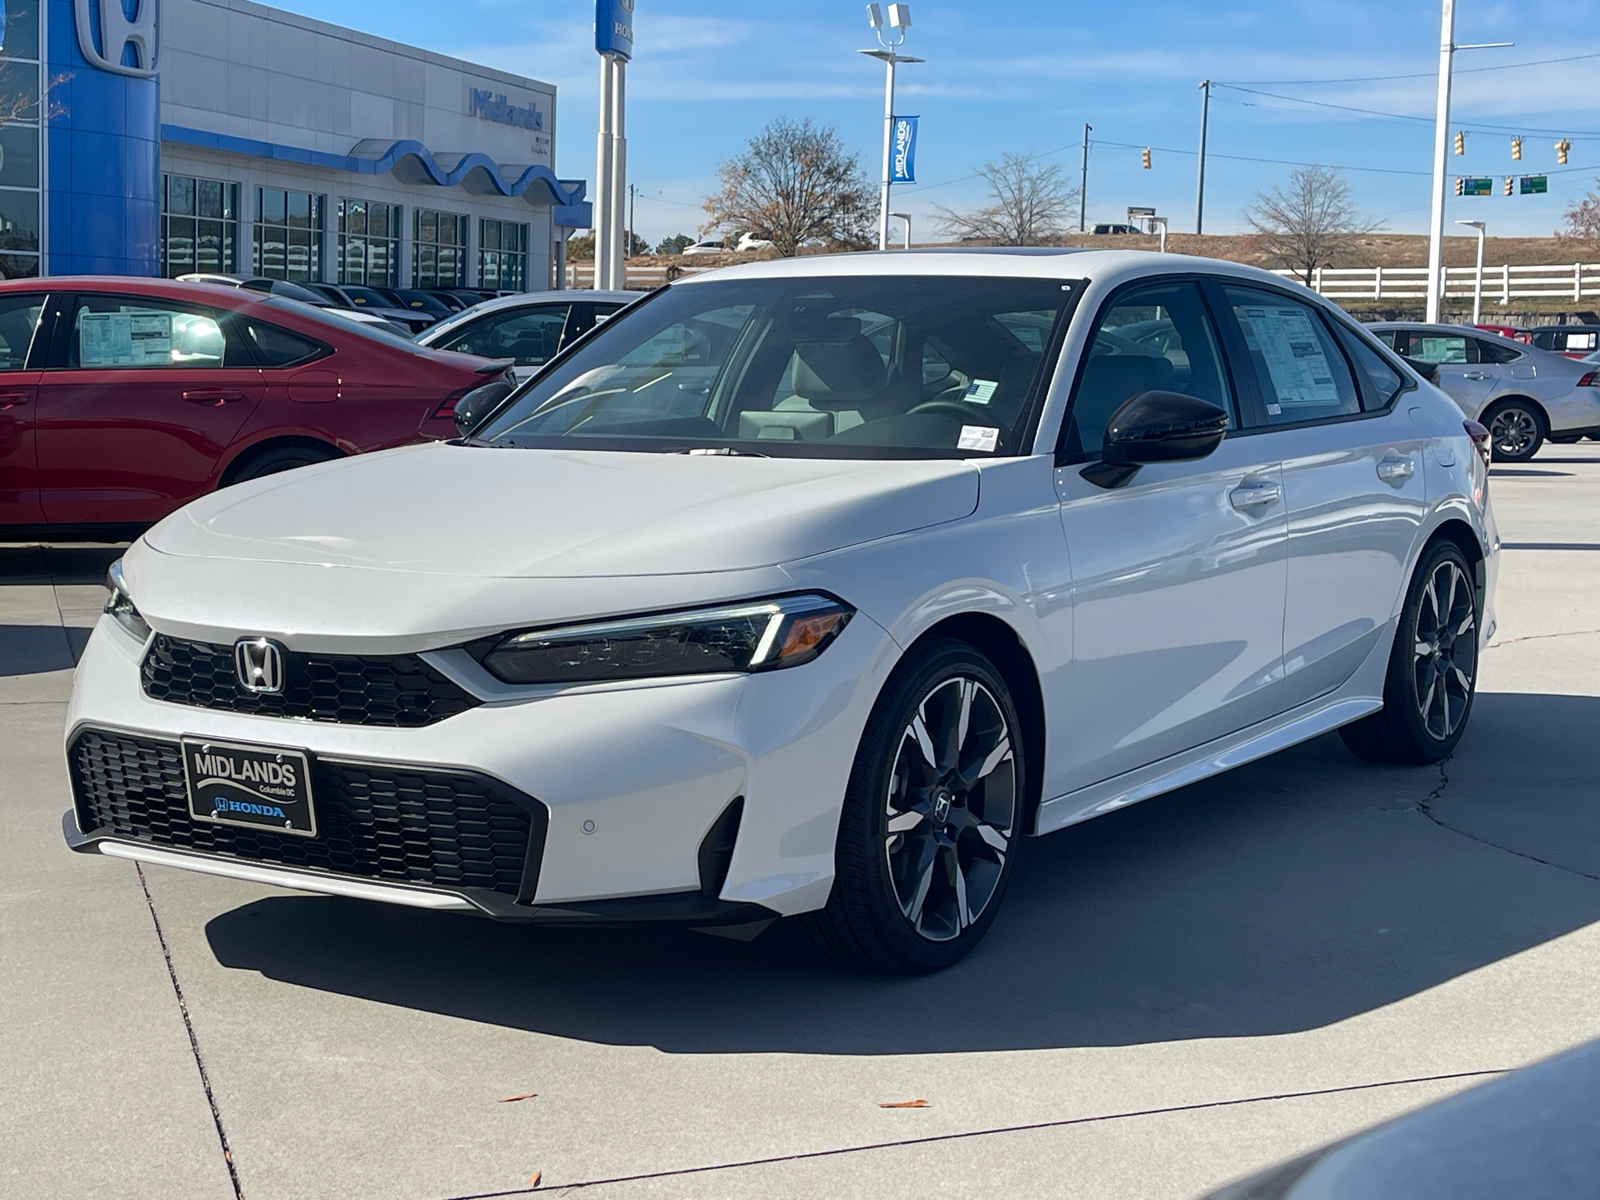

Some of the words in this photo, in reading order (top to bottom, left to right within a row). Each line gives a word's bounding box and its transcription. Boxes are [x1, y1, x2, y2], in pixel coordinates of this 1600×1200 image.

[469, 87, 543, 131] Midlands
[895, 120, 906, 177] MIDLANDS
[194, 753, 297, 787] MIDLANDS
[259, 784, 286, 796] Columbia
[286, 788, 296, 797] SC
[229, 801, 286, 818] HONDA
